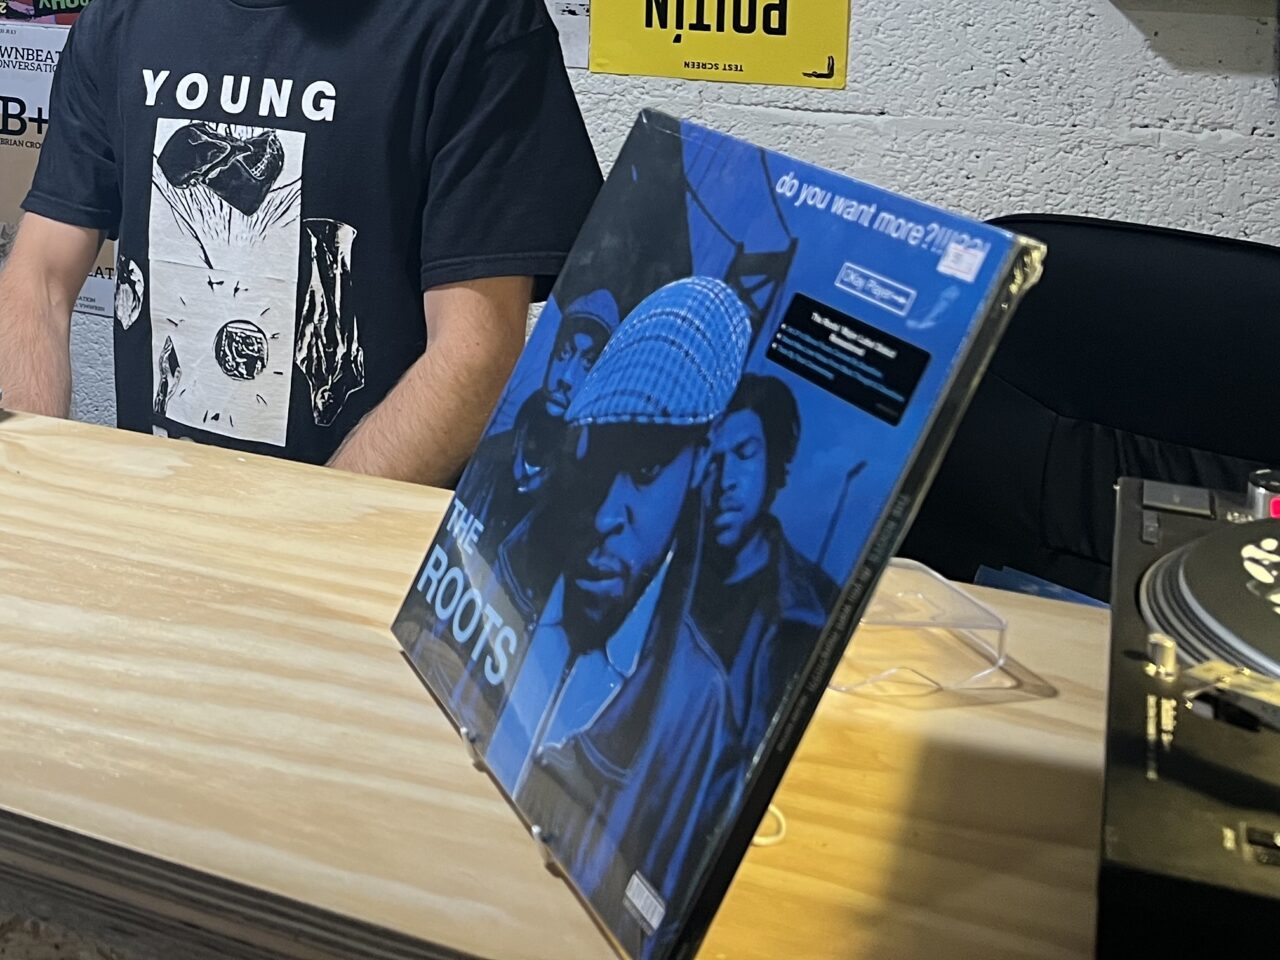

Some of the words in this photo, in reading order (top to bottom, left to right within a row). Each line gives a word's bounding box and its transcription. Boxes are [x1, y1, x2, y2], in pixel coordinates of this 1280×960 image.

[683, 60, 719, 70] SCREEN
[722, 62, 744, 72] TEST
[142, 69, 338, 122] YOUNG
[775, 171, 799, 197] do
[794, 185, 831, 210] you
[831, 192, 877, 227] want
[449, 495, 486, 558] THE
[416, 546, 521, 689] ROOTS
